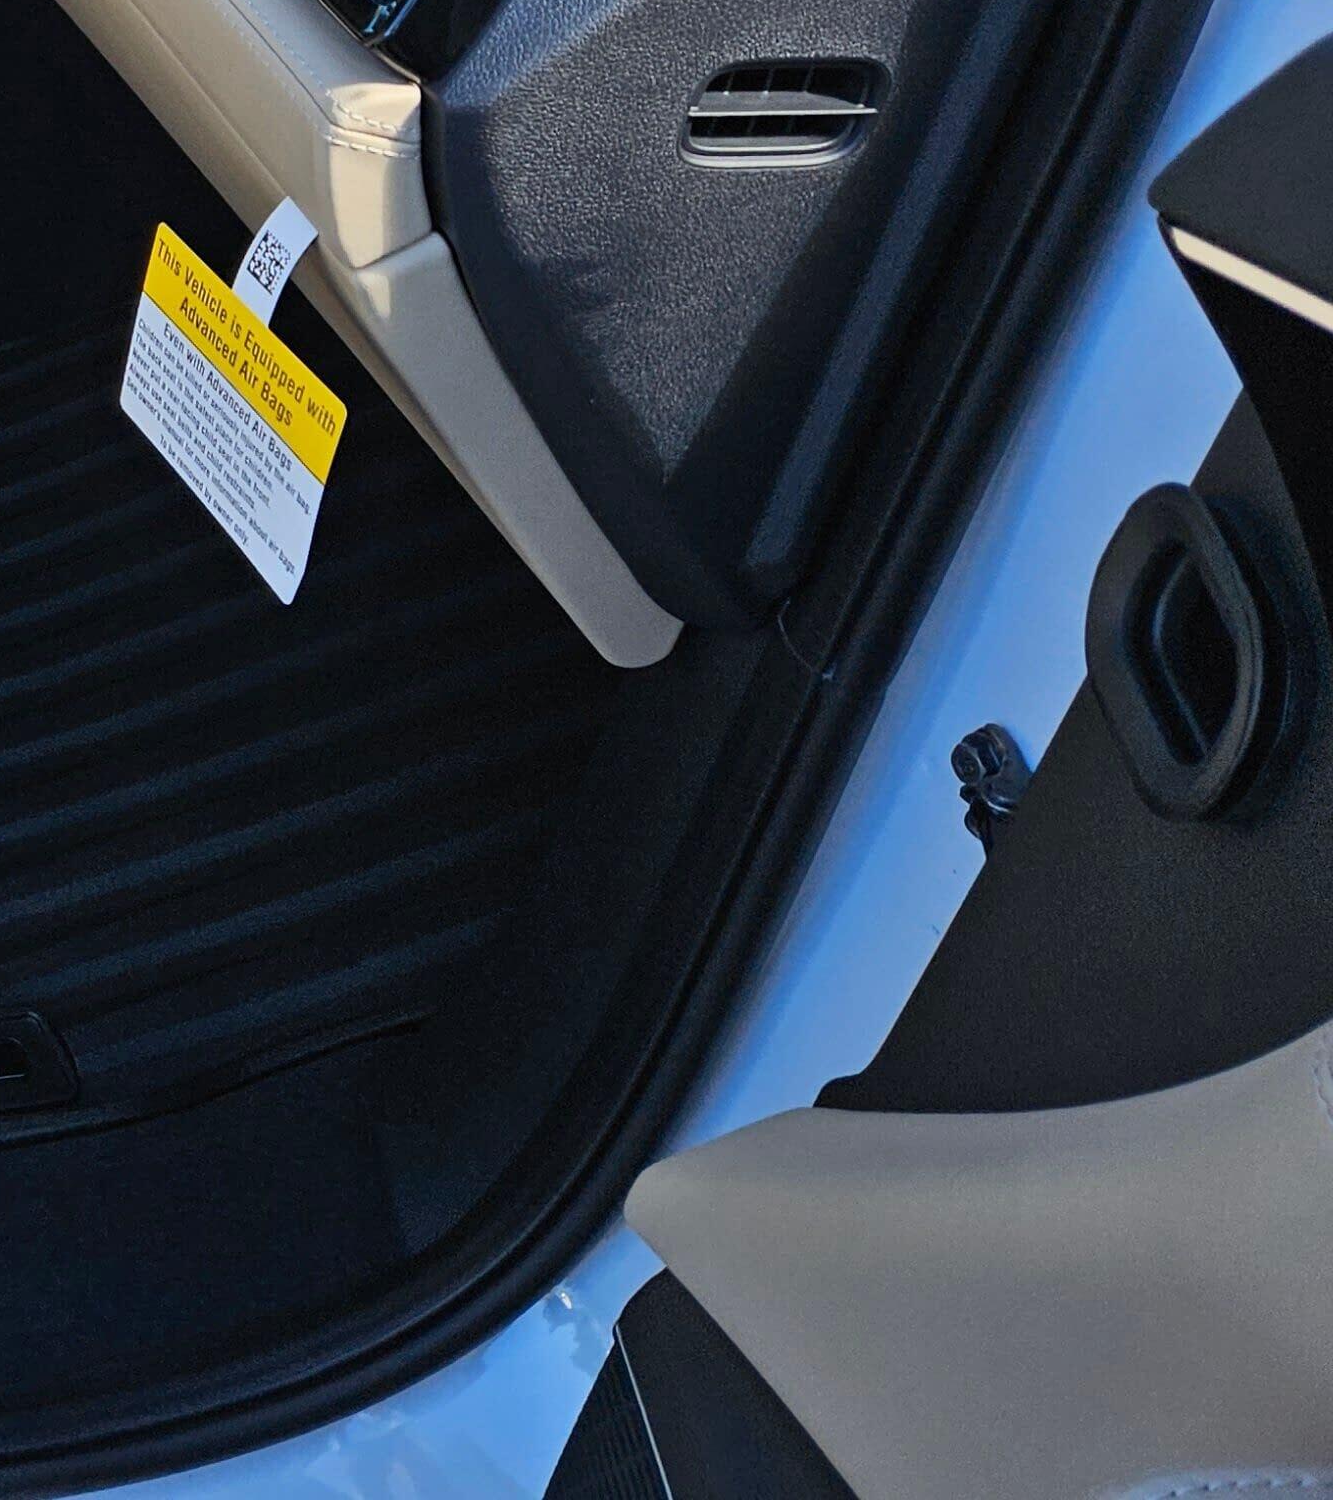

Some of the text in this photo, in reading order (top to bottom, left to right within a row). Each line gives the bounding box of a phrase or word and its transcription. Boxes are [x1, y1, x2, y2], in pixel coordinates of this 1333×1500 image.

[157, 237, 336, 436] This Vehicle is Equipped with
[163, 322, 292, 471] Even with Advanced Air Bags
[178, 296, 292, 426] Advanced Air Bags
